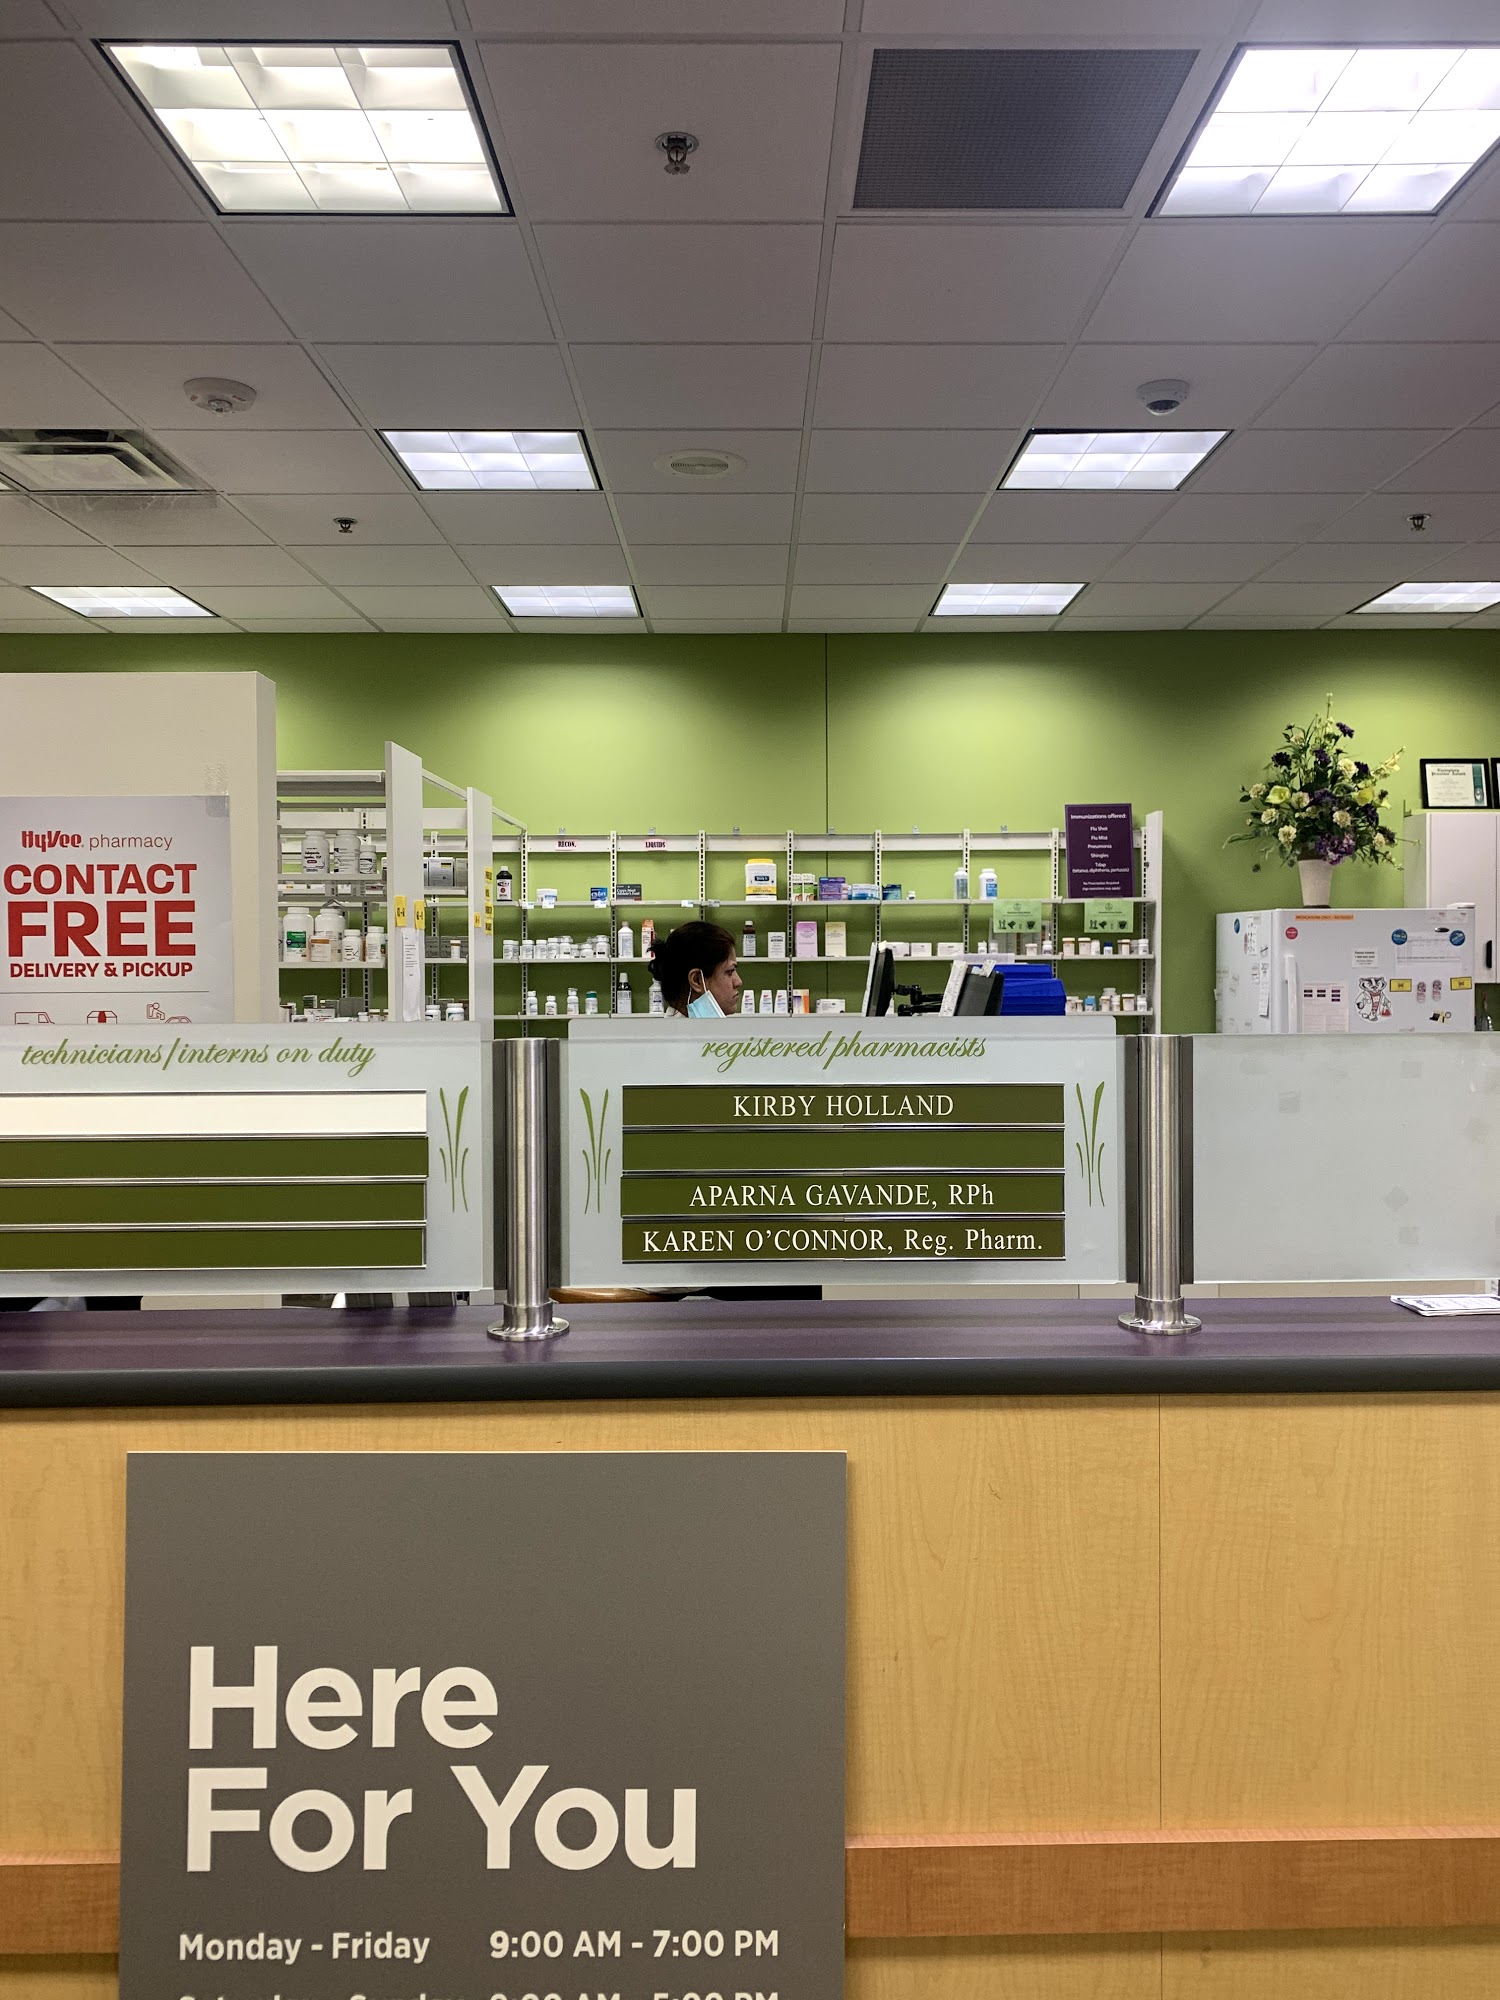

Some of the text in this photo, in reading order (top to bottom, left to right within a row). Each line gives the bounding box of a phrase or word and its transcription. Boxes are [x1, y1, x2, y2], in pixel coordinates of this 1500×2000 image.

[89, 834, 173, 851] pharmacy
[3, 863, 197, 895] CONTACT
[7, 900, 197, 957] FREE
[10, 962, 193, 978] DELIVERY & PICKUP
[276, 1049, 312, 1064] on
[318, 1037, 376, 1078] duty
[701, 1030, 987, 1073] registered pharmacists
[733, 1094, 955, 1118] KIRBY HOLLAND
[690, 1182, 995, 1210] APARNA GAVANDE, RPh
[643, 1228, 1043, 1256] KAREN O'CONNOR, Reg. Pharm.
[188, 1645, 499, 1750] Here
[187, 1765, 697, 1872] For You
[179, 1932, 302, 1965] Monday
[332, 1931, 430, 1964] Friday
[489, 1930, 564, 1958] 9:00
[572, 1930, 622, 1957] AM
[652, 1930, 725, 1957] 7:00
[734, 1930, 779, 1956] PM
